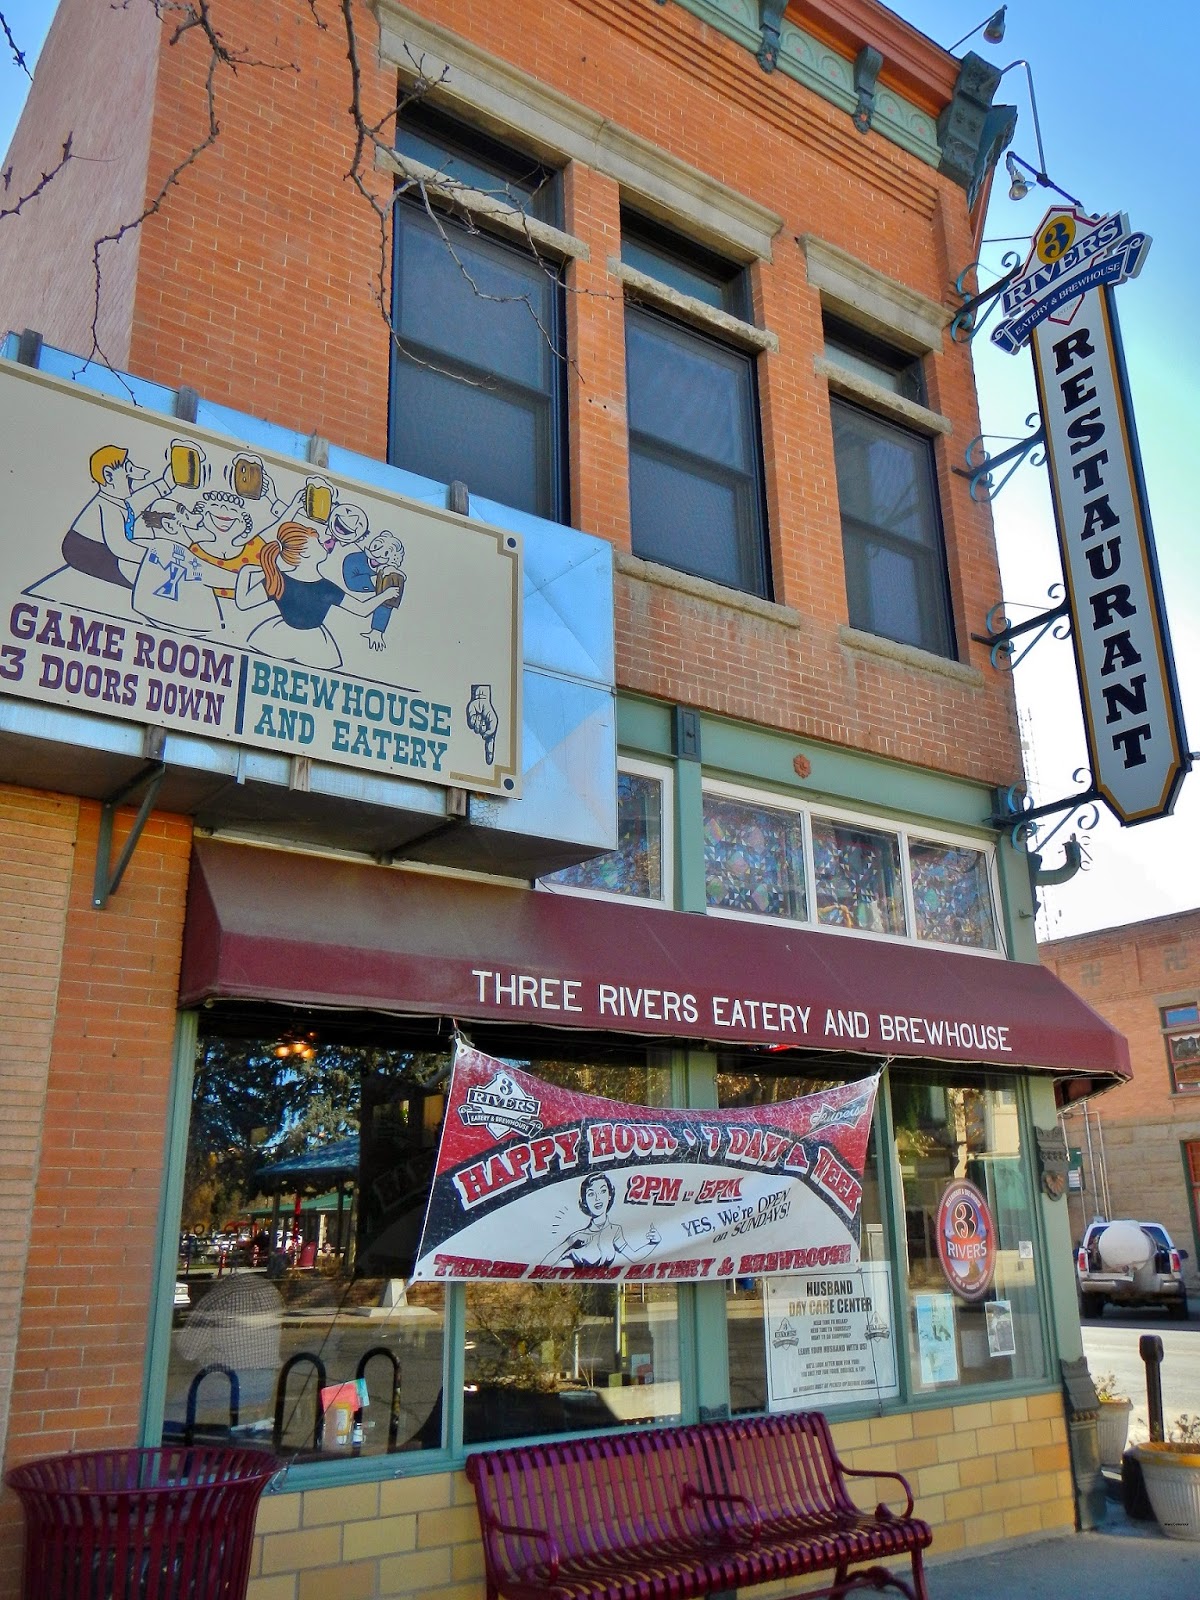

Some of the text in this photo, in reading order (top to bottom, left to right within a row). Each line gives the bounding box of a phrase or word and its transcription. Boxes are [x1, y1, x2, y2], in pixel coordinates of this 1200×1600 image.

[1045, 222, 1070, 259] 3
[1006, 219, 1119, 309] RIVERS
[1015, 302, 1049, 336] EATERY
[1059, 262, 1121, 300] BREWHOUSE
[1052, 328, 1152, 770] RESTAURANT
[9, 602, 234, 687] GAME ROOM
[0, 645, 225, 726] 3 DOORS DOWN
[251, 660, 452, 737] BREWHOUSE
[254, 704, 448, 772] AND EATERY
[471, 969, 1013, 1051] THREE RIVERS EATERY AND BREWHOUSE
[472, 1091, 536, 1113] RIVERS
[500, 1078, 514, 1095] 3
[495, 1116, 530, 1132] BREWHOUSE
[454, 1129, 580, 1208] HAPPY
[589, 1123, 679, 1162] HOUR
[701, 1126, 721, 1156] 7
[726, 1128, 792, 1166] DAYS
[785, 1143, 809, 1173] A
[624, 1174, 683, 1206] 2PM
[695, 1177, 744, 1204] 5PM
[681, 1188, 791, 1237] YES, We're OPEN
[713, 1201, 791, 1243] on SUNDAYS!
[954, 1202, 977, 1239] 3
[717, 1256, 735, 1276] &
[947, 1240, 987, 1258] RIVERS
[789, 1296, 873, 1317] DAY CARE CENTER
[806, 1280, 854, 1297] HUSBAND
